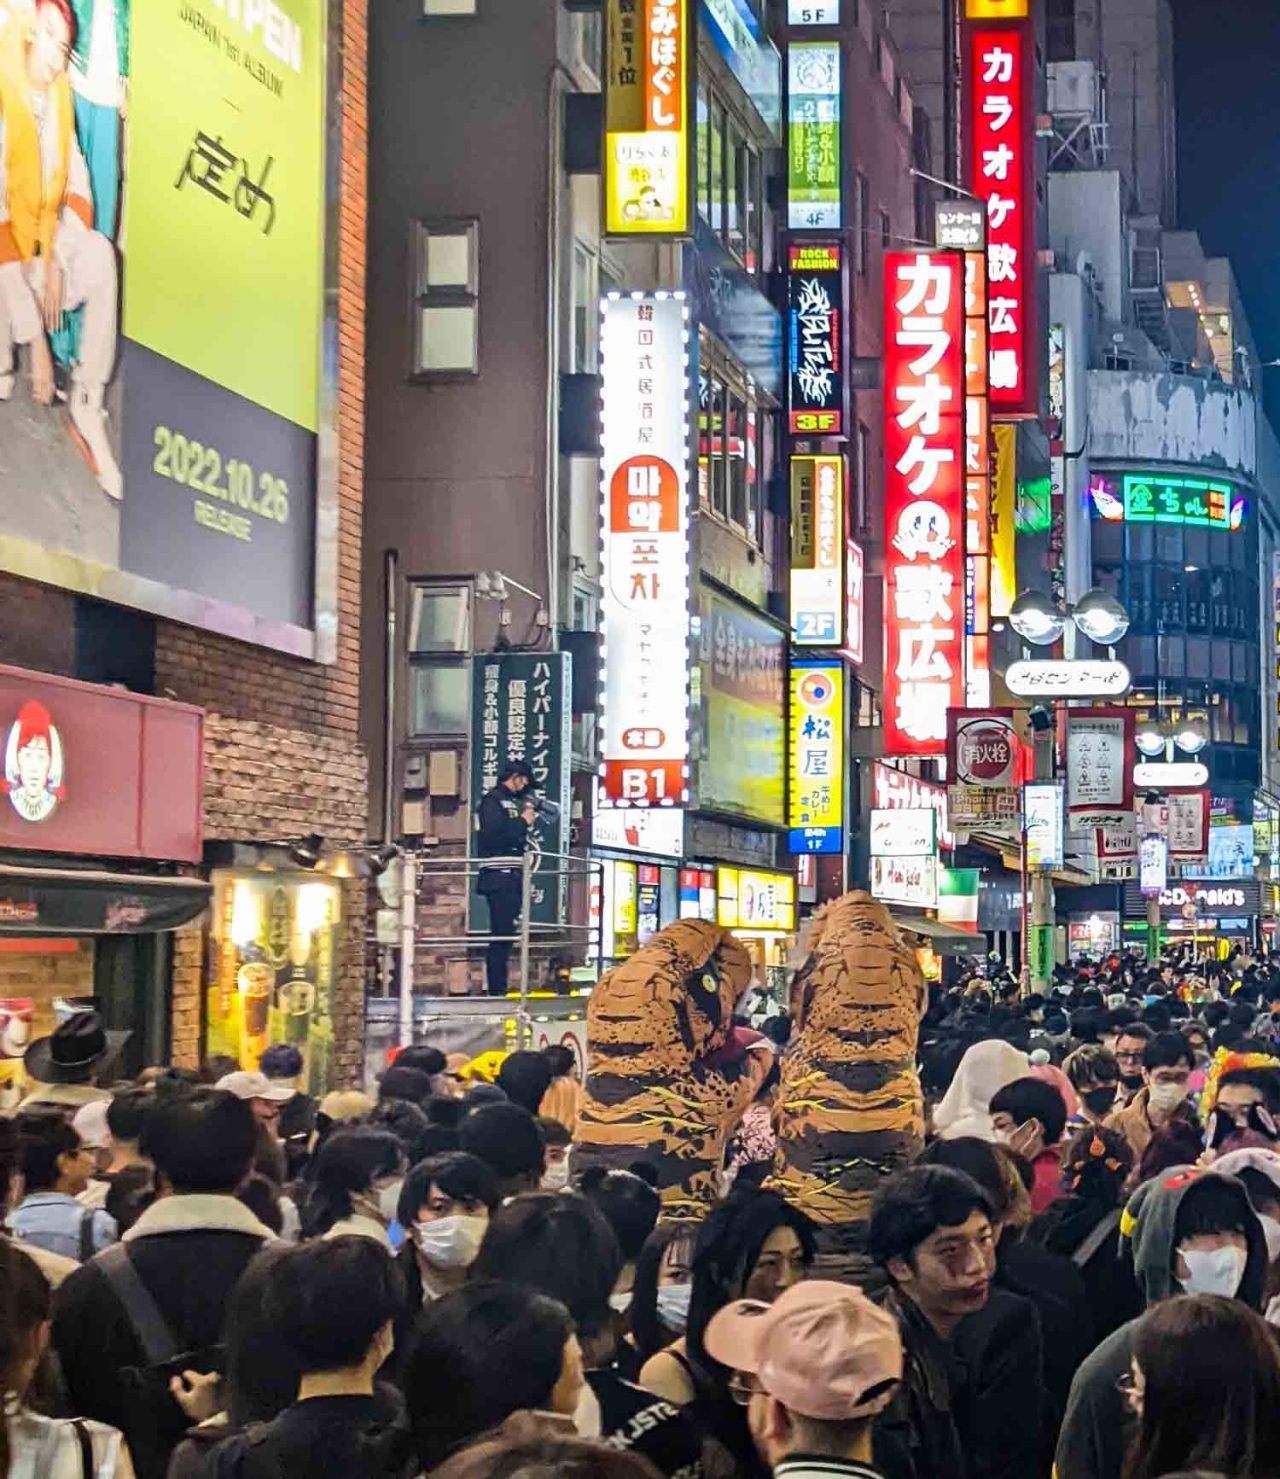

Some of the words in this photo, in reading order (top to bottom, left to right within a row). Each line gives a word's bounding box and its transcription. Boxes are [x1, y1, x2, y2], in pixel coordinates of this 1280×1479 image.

[802, 9, 825, 21] 5F
[651, 0, 678, 126] みほぐし
[806, 213, 825, 225] 4F
[791, 259, 838, 270] FASHION
[800, 249, 829, 259] ROCK
[895, 255, 953, 496] カラオケ
[796, 414, 835, 430] 3F
[153, 425, 290, 526] 2022.10.26
[194, 501, 254, 543] RELEASE
[802, 614, 834, 637] 2F
[895, 565, 954, 741] 歌広場
[802, 714, 831, 776] 松屋
[964, 743, 1008, 763] 消火栓
[622, 768, 666, 798] B1
[807, 840, 823, 850] 1F
